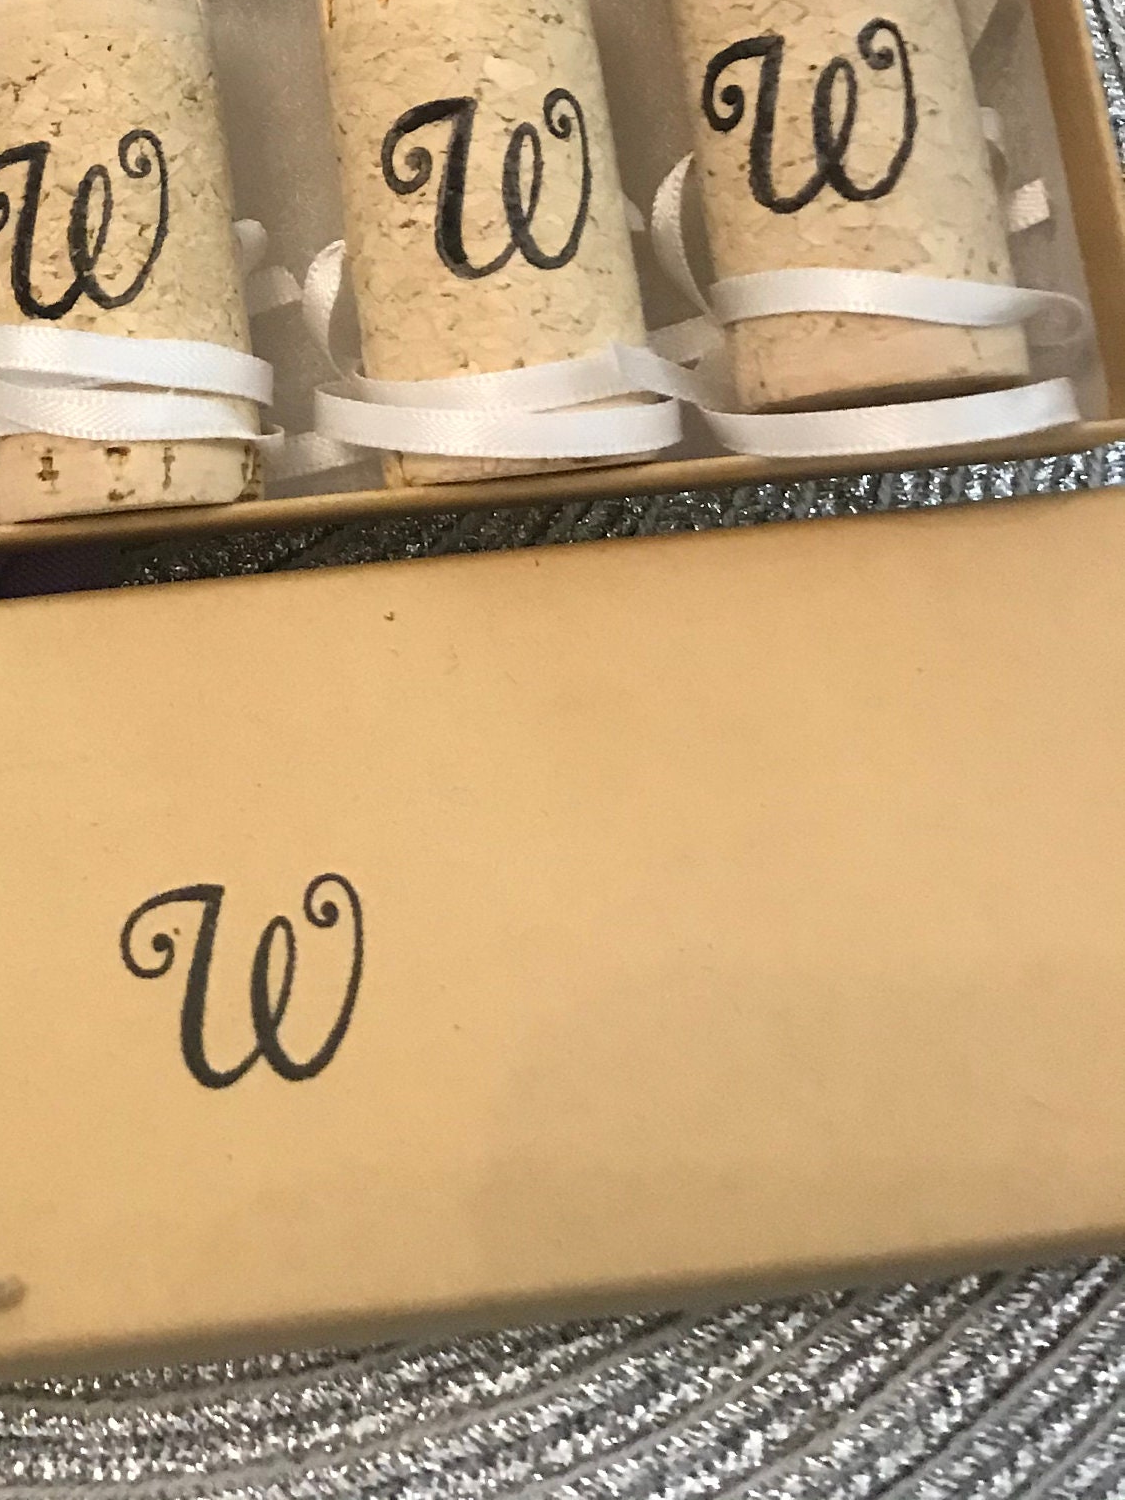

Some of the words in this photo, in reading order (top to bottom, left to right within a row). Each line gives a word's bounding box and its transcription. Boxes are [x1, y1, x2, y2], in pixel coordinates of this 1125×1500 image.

[380, 87, 593, 280] W
[700, 19, 918, 215] W
[119, 873, 365, 1090] W
